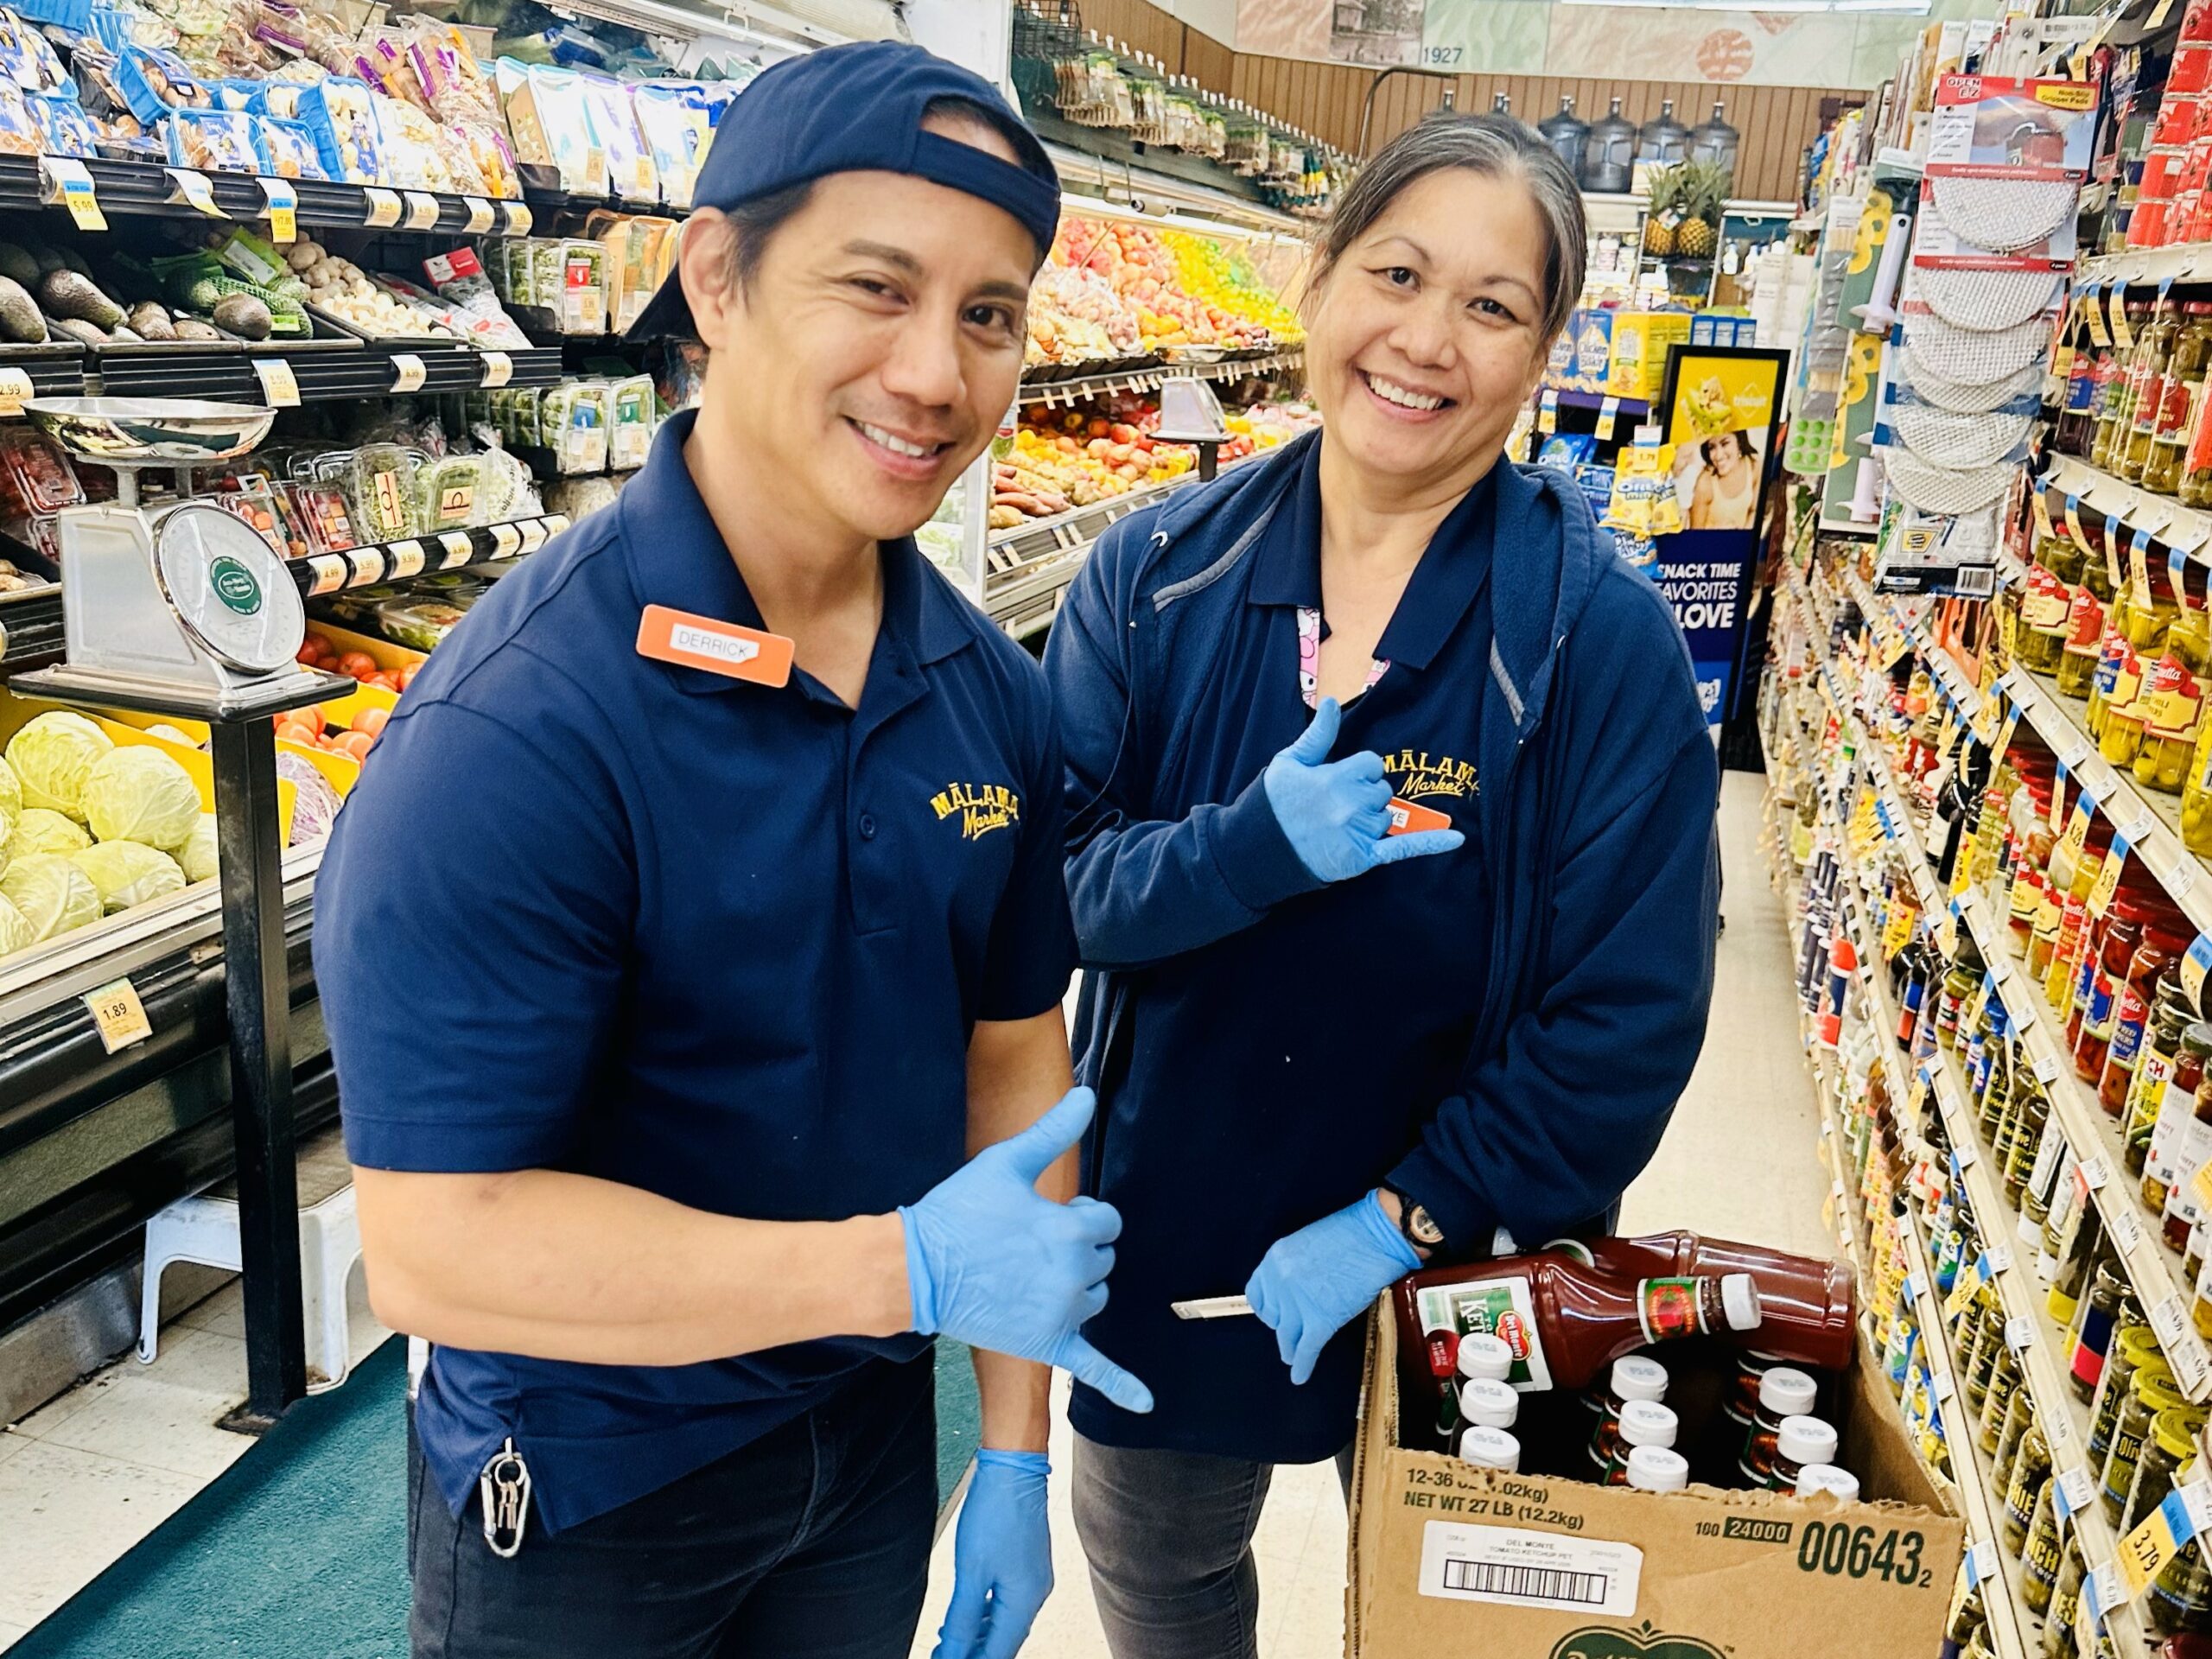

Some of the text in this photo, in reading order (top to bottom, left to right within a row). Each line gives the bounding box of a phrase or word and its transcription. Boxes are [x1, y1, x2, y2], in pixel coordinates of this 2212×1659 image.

[1424, 47, 1463, 64] 1927
[1948, 77, 1981, 86] OPEN
[1710, 563, 1742, 578] TIME
[678, 631, 749, 657] DERRICK
[1397, 772, 1466, 796] Market
[930, 782, 1019, 820] MĀLAMA
[963, 805, 1008, 838] Market
[103, 1002, 127, 1020] 1.89
[1408, 1469, 1453, 1487] 12-36
[1484, 1481, 1549, 1504] .02kg)
[1404, 1491, 1584, 1530] NET WT 27 LB (12.2kg)
[1490, 1546, 1521, 1555] TOMATO
[1525, 1541, 1554, 1549] MONTE
[1695, 1522, 1719, 1537] 100
[1728, 1520, 1789, 1541] 24000
[1798, 1521, 1924, 1585] 00643
[2133, 1529, 2160, 1572] 3.79
